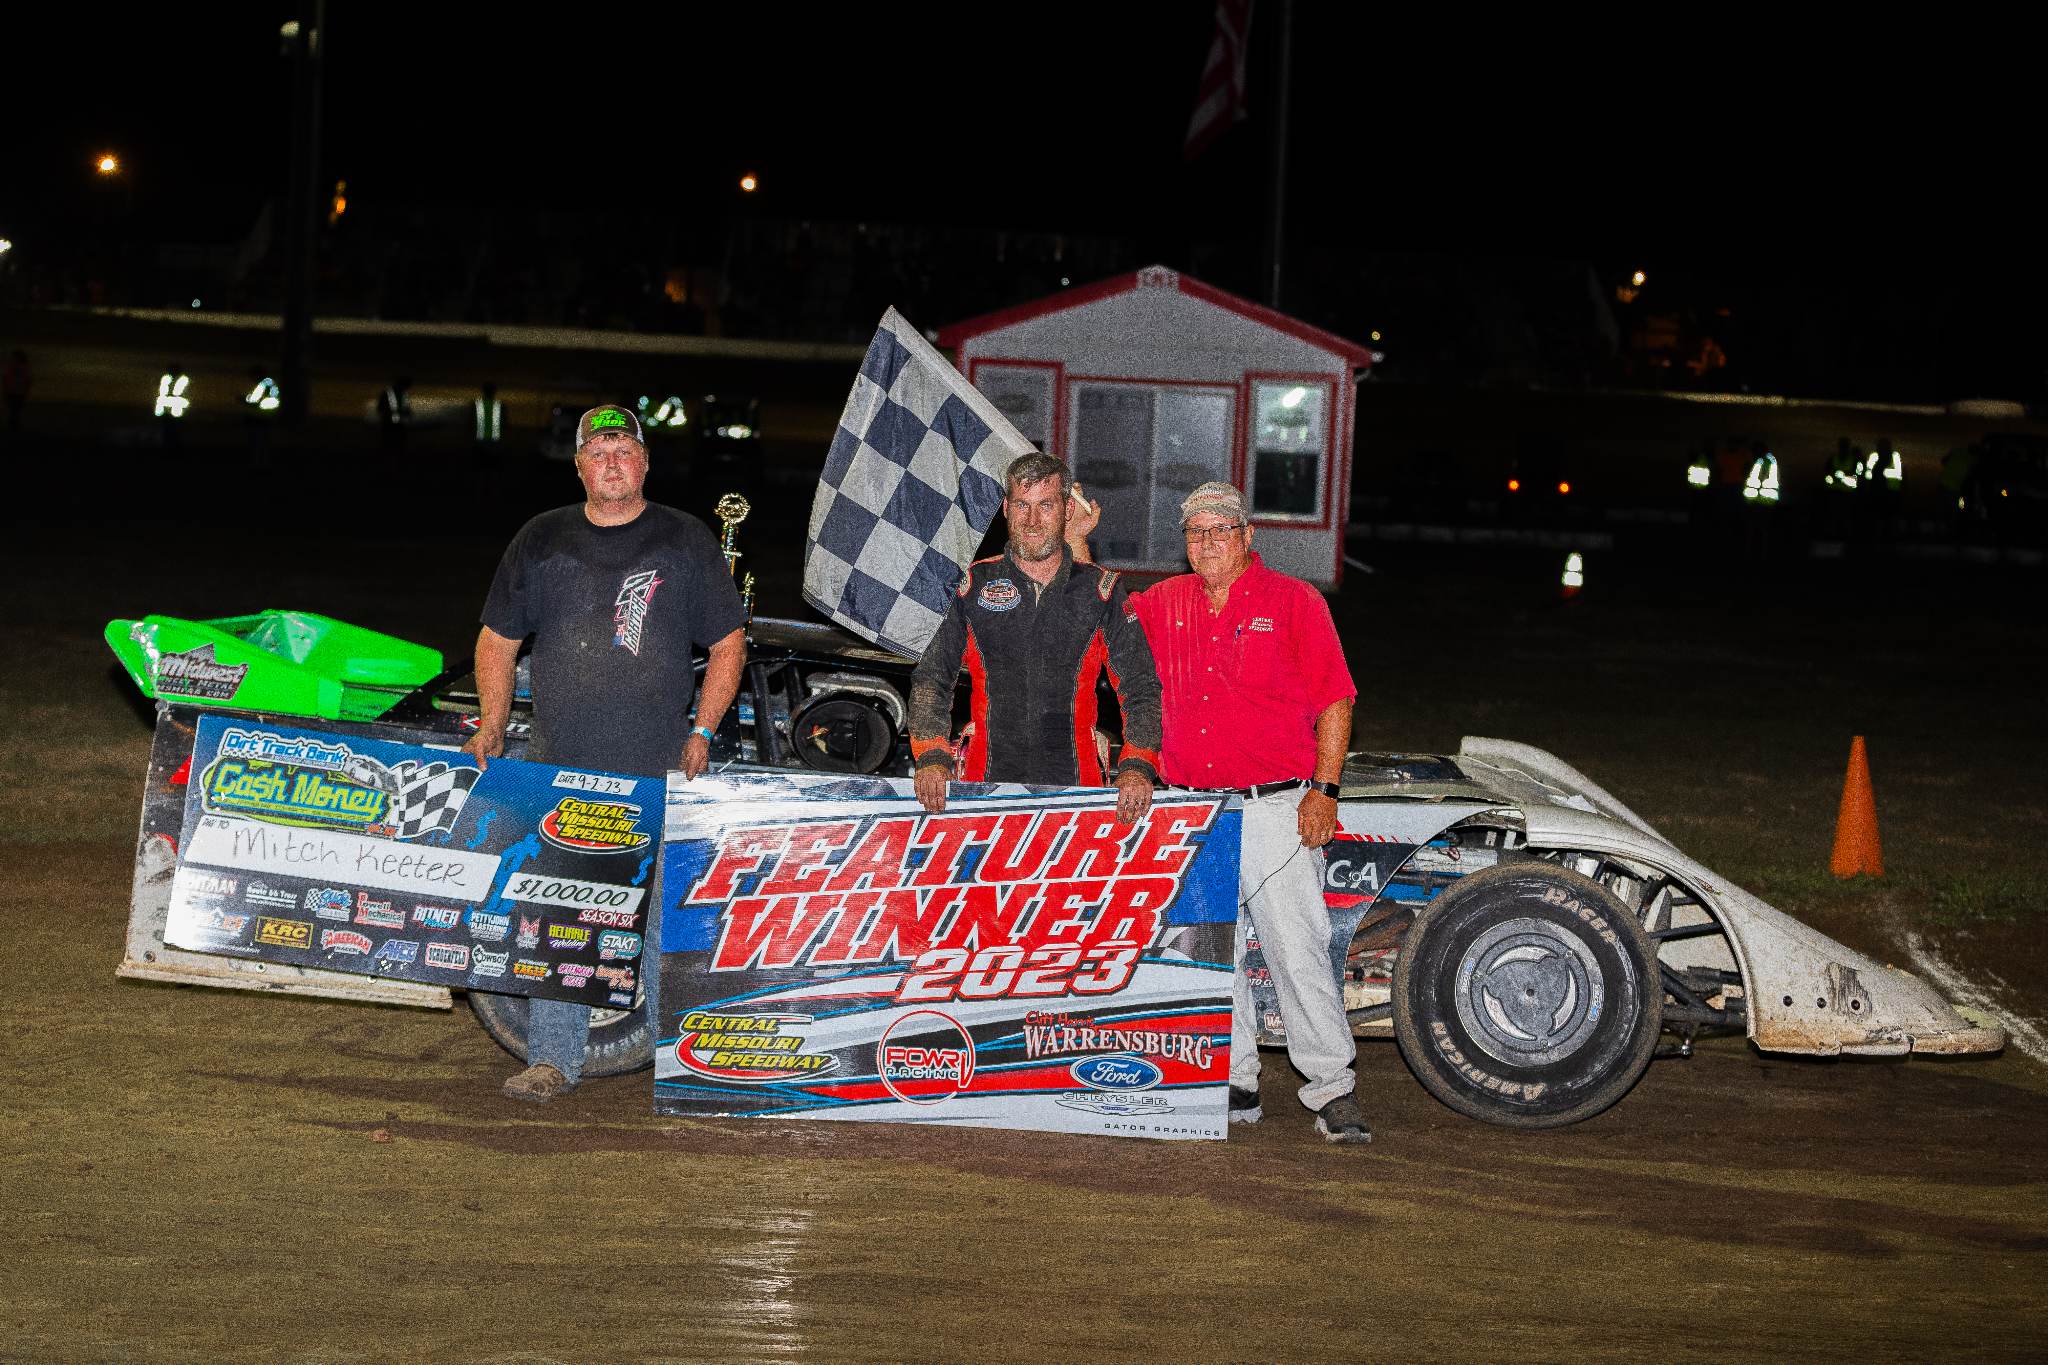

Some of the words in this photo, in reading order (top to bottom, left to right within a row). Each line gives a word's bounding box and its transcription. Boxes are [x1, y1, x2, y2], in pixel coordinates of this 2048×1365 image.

[225, 734, 261, 751] Dirt
[262, 738, 306, 757] Track
[306, 746, 346, 764] Bank
[557, 774, 577, 784] DATE
[290, 774, 385, 820] Money
[559, 798, 626, 819] CENTRAL
[218, 820, 230, 830] TO
[557, 811, 636, 832] MISSOURI
[559, 824, 646, 846] SPEEDWAY
[232, 827, 340, 866] Mitch
[684, 801, 1222, 906] FEATURE
[513, 878, 630, 908] $1,000.00
[357, 907, 406, 924] Mechanical
[578, 908, 619, 926] SEASON
[618, 913, 640, 928] SIX
[708, 876, 1179, 974] WINNER
[1542, 885, 1622, 945] RACER
[261, 920, 309, 939] KRC
[602, 934, 638, 950] STAKT
[893, 939, 1143, 1002] 2023
[682, 1013, 780, 1033] CENTRAL
[693, 1032, 800, 1051] MISSOURI
[1022, 1024, 1214, 1070] WARRENSBURG
[709, 1050, 830, 1070] SPEEDWAY
[1430, 1021, 1548, 1102] AMERICAN
[885, 1067, 961, 1080] RACING
[1091, 1060, 1141, 1086] Ford
[1062, 1091, 1169, 1107] CHRYSLER
[1104, 1123, 1146, 1132] GATOR
[1154, 1126, 1221, 1137] GRAPHICS
